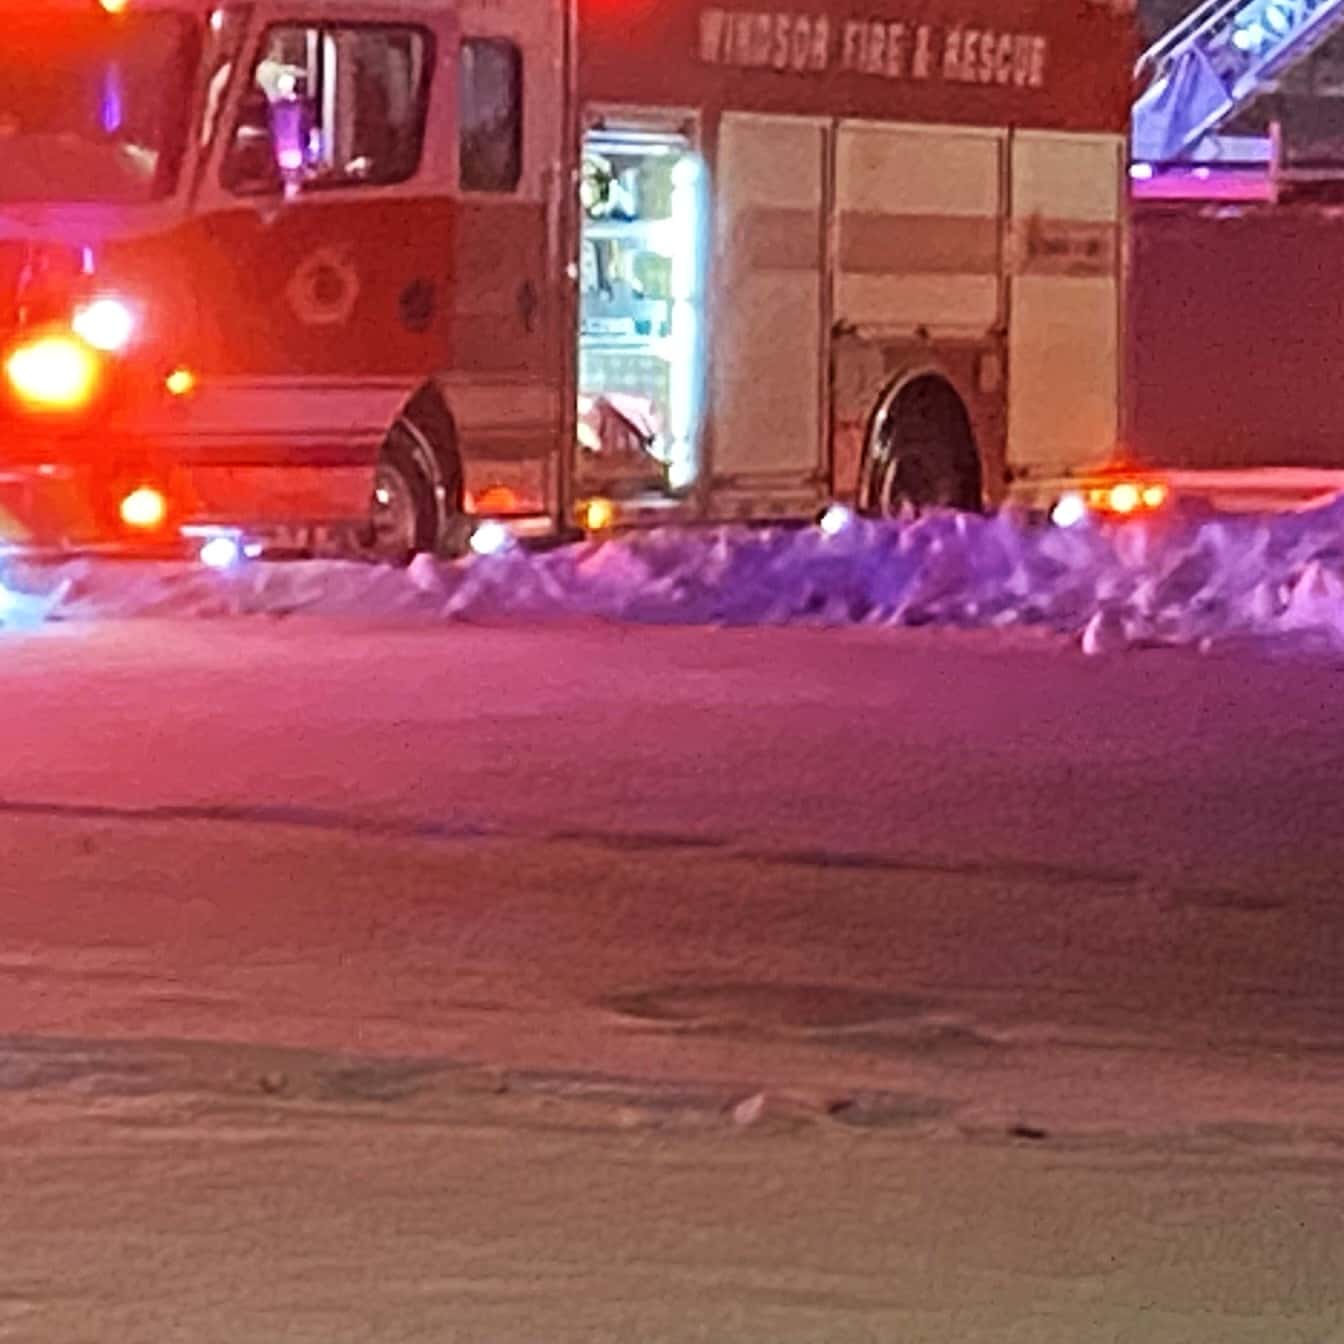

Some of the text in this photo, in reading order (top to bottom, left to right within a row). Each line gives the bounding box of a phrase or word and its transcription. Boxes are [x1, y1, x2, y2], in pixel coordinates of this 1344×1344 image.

[699, 10, 1046, 87] WINDSOR FIRE & RESCUE
